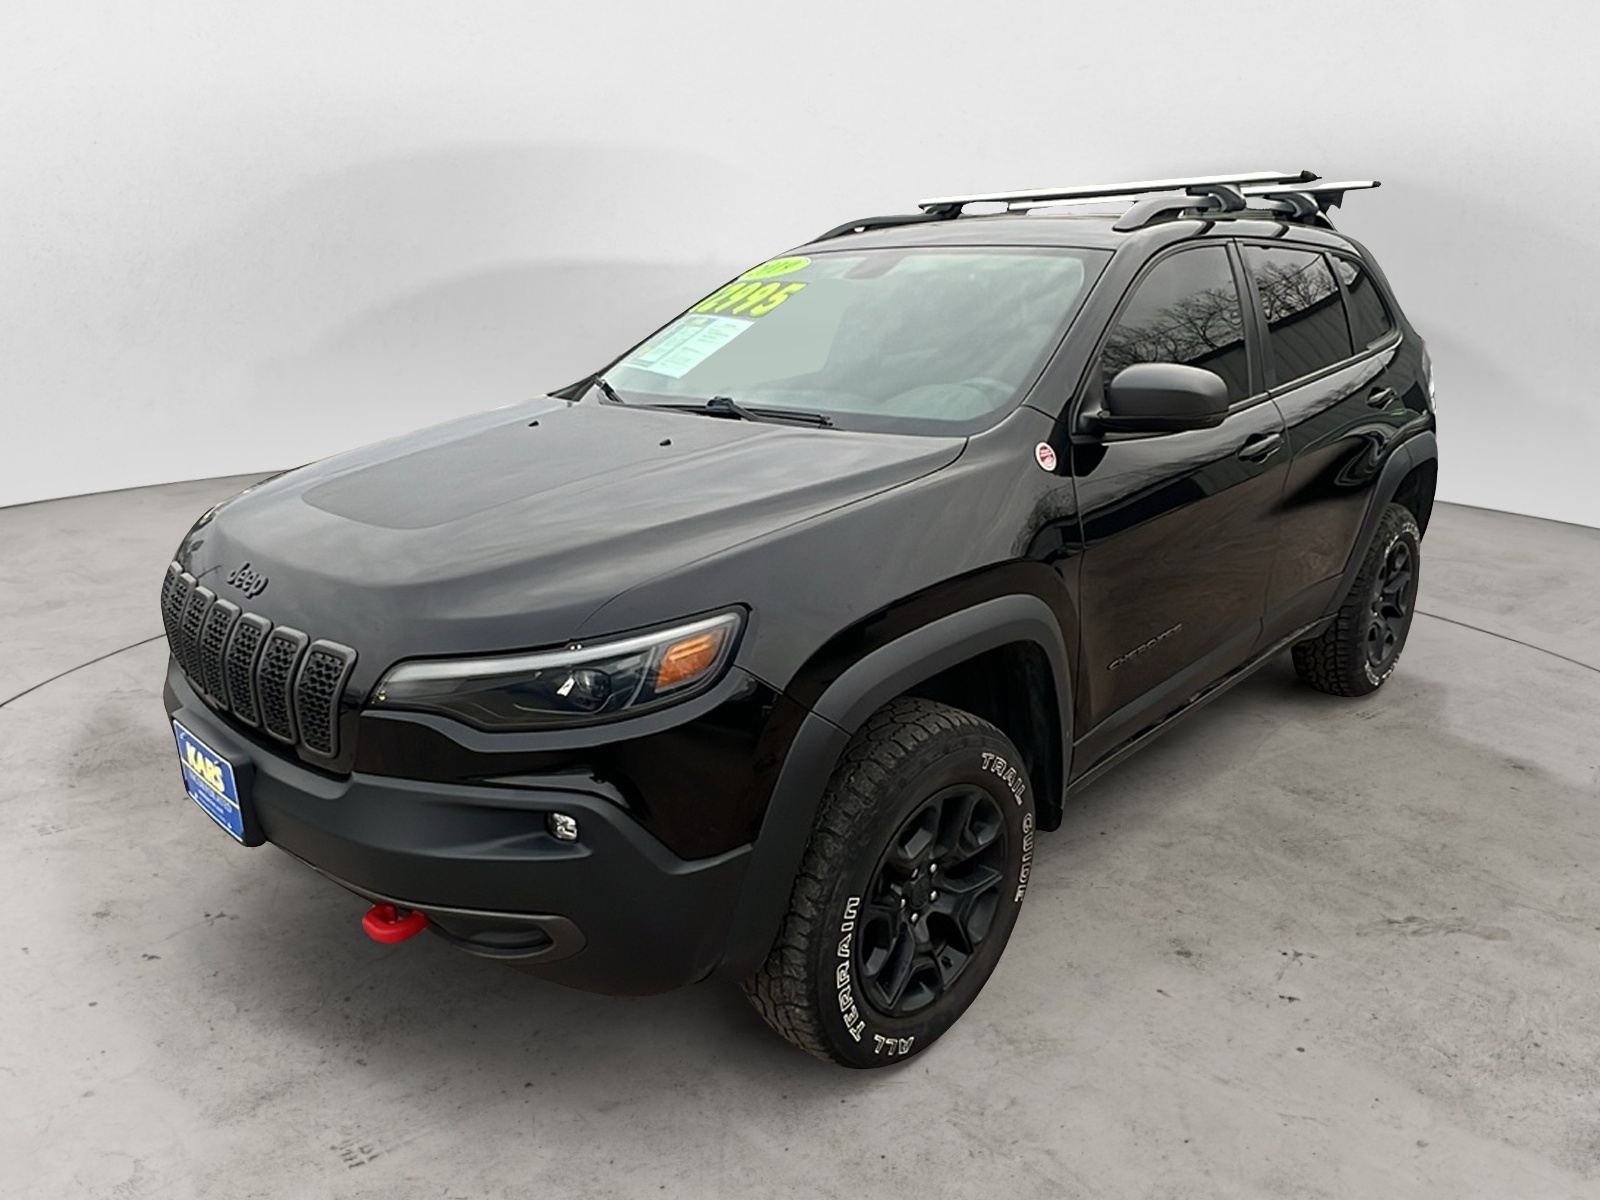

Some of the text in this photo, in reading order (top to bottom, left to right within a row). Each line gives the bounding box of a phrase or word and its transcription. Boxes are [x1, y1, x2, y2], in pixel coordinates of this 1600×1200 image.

[226, 561, 269, 600] Jeep
[981, 752, 1034, 903] TRAIL GUIDE
[836, 897, 915, 1056] ALL TERRAIN
